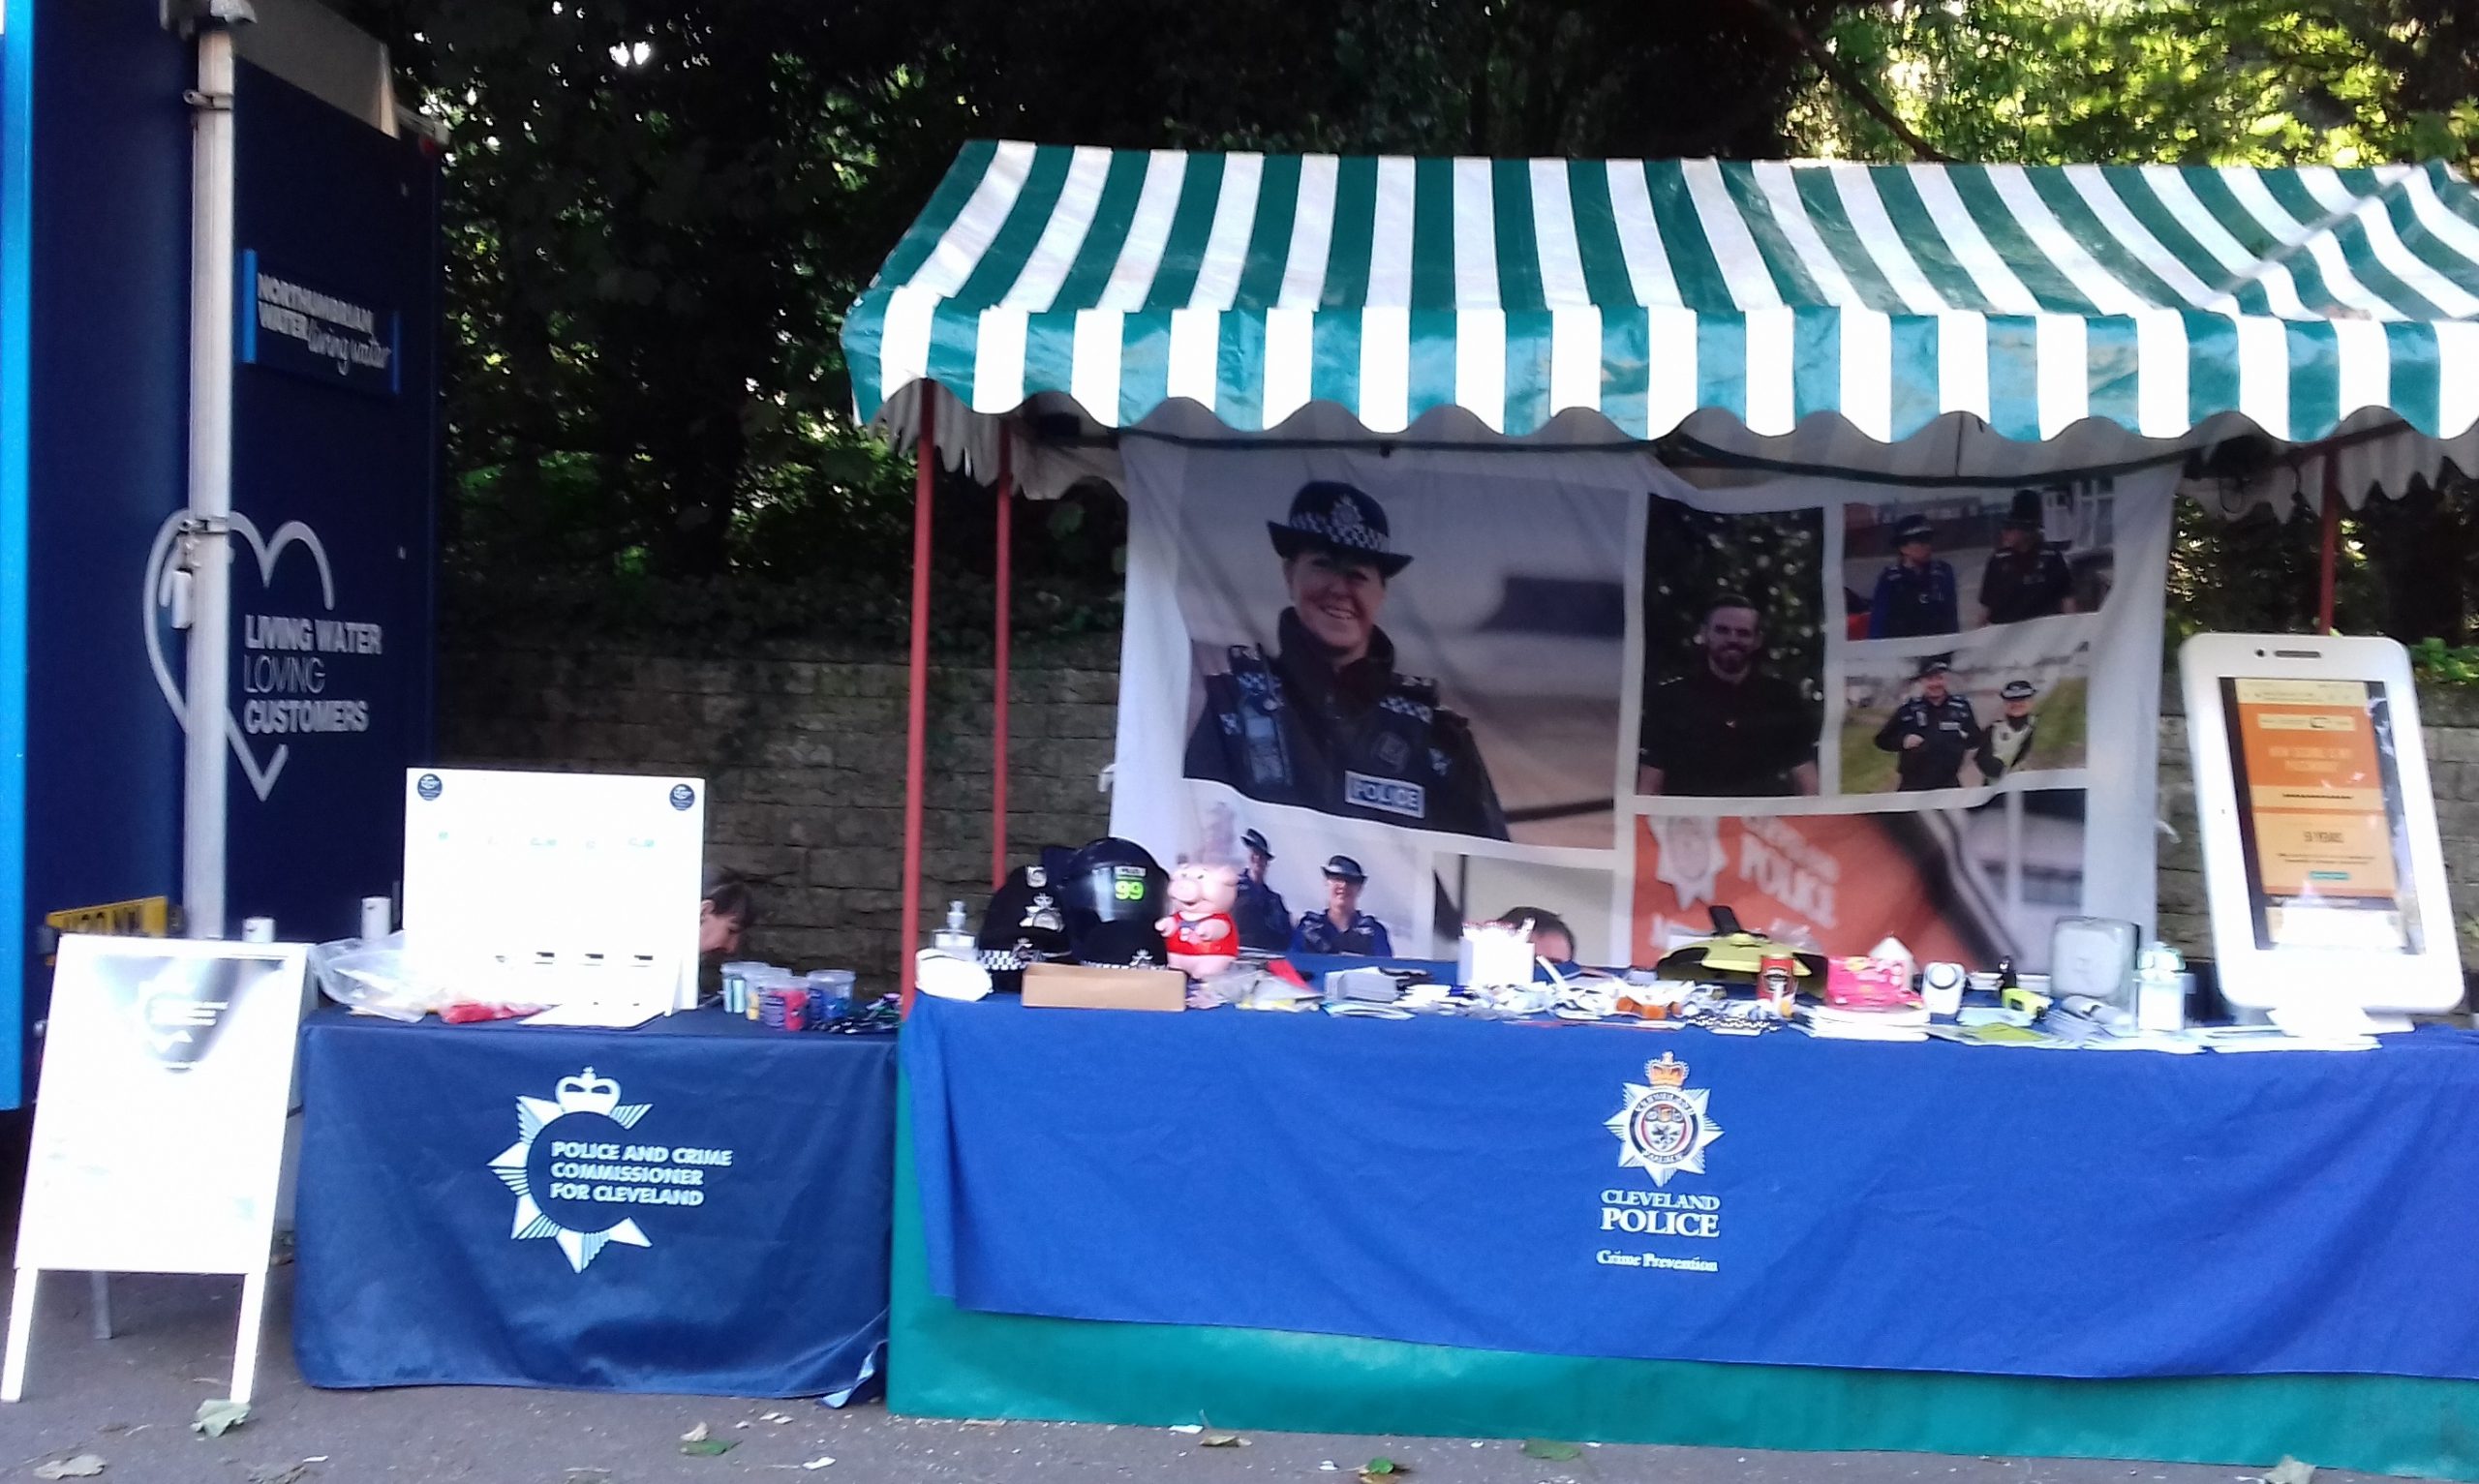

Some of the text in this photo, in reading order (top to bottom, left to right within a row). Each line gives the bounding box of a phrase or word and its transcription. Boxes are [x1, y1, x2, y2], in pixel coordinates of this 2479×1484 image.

[245, 614, 383, 654] LIVING WATER
[243, 653, 326, 693] LOVING
[243, 698, 369, 735] CUSTOMERS
[1352, 778, 1419, 810] POLICE
[1115, 880, 1144, 900] 99
[551, 1141, 733, 1166] POLICE AND CRIME
[550, 1162, 704, 1186] COMMISSIONER
[549, 1182, 705, 1206] FOR CLEVELAND
[1600, 1189, 1721, 1211] CLEVELAND
[1599, 1206, 1721, 1238] POLICE
[1596, 1249, 1719, 1272] Crime Prevention
